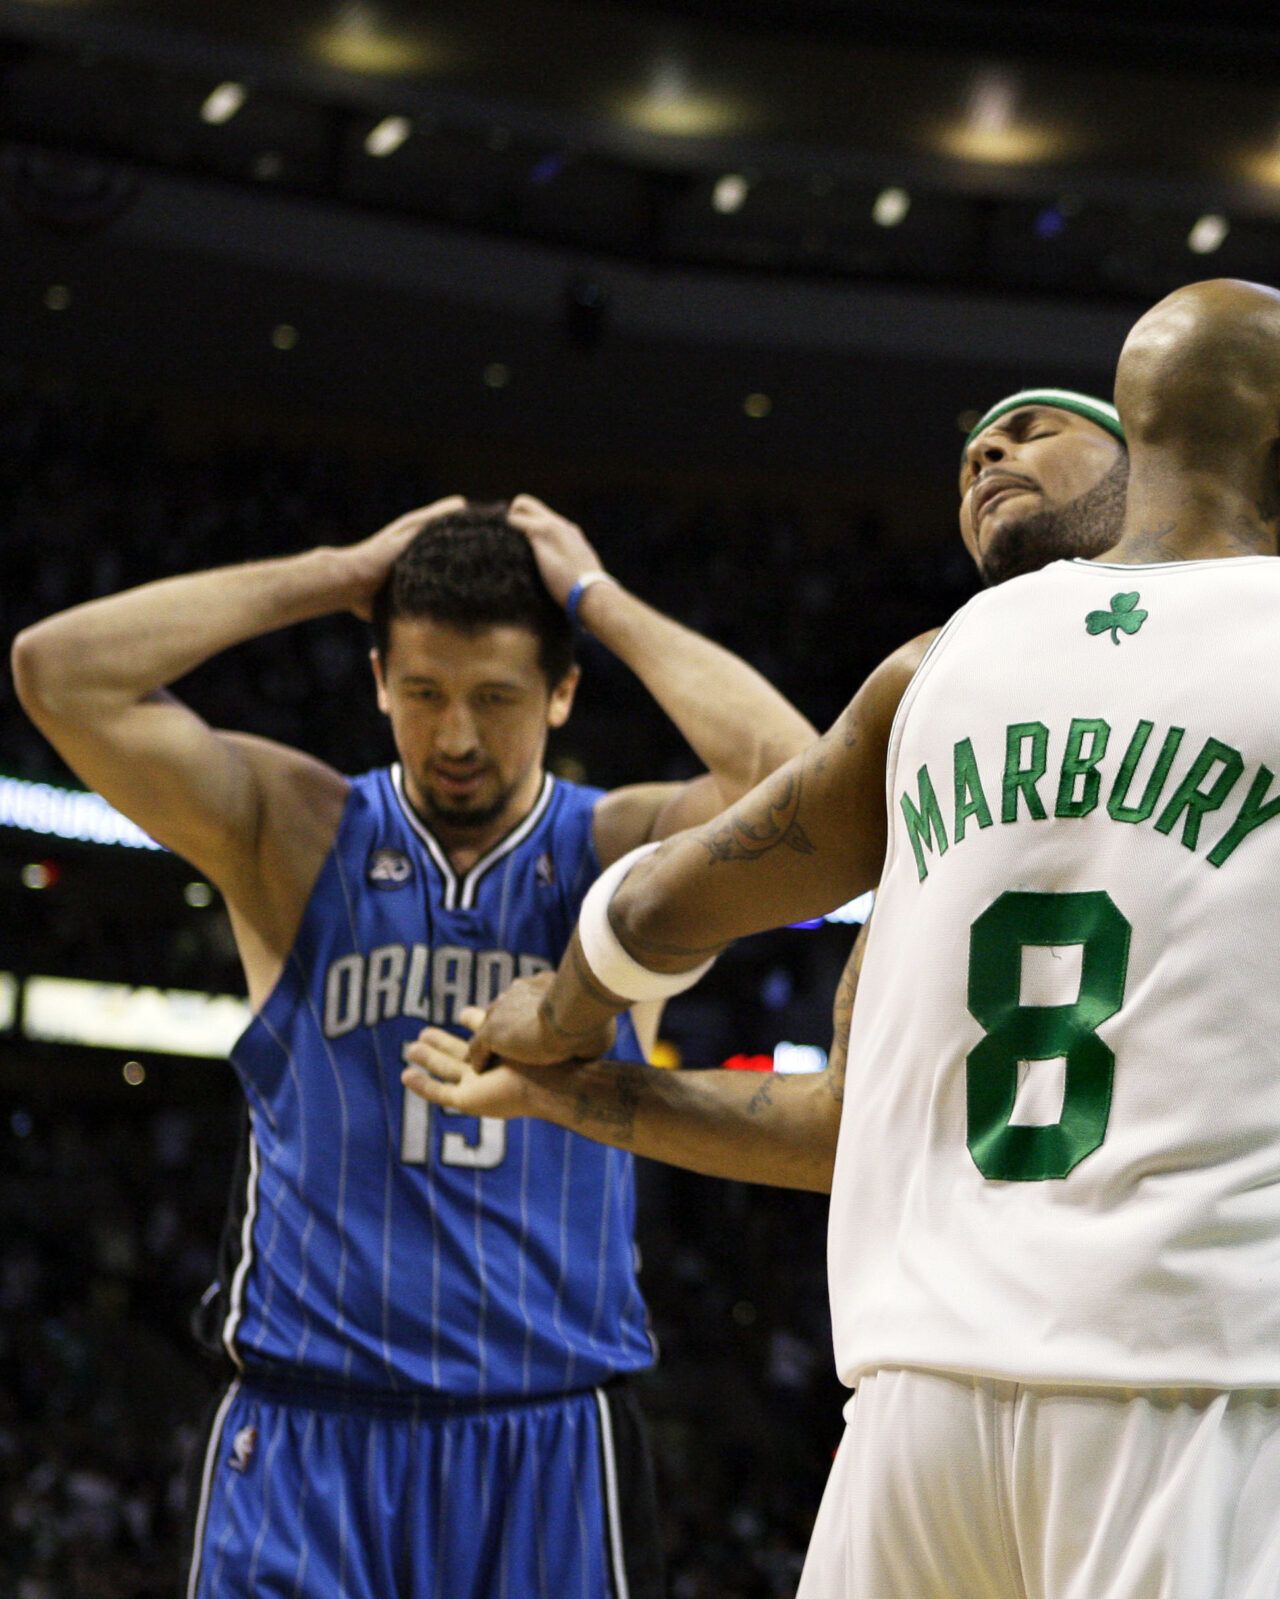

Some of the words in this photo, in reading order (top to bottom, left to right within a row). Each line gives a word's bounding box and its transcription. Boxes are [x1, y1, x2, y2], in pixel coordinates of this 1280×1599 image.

[370, 856, 412, 882] 20
[323, 943, 556, 1040] ORLAN
[965, 889, 1133, 1180] 8
